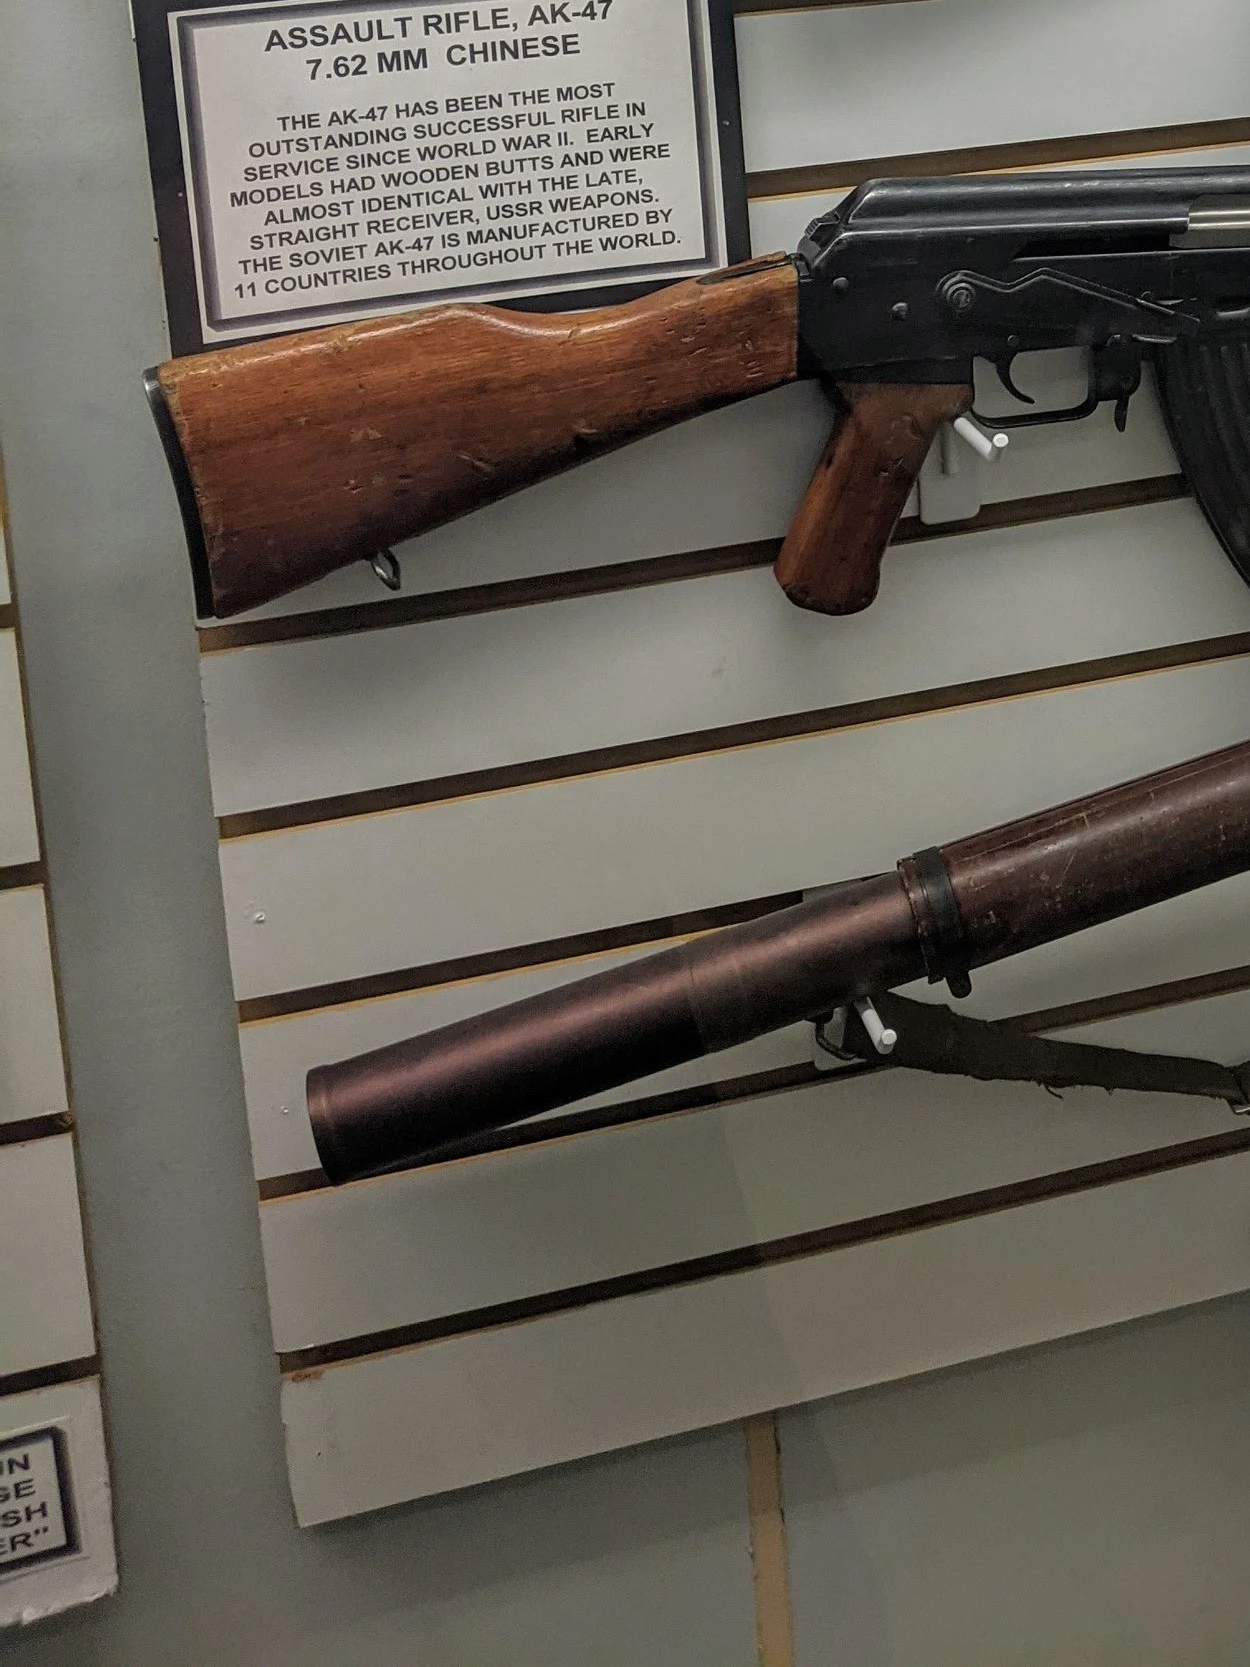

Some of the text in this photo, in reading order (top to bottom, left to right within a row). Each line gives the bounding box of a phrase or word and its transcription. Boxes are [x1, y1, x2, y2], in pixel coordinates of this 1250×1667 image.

[264, 16, 413, 52] ASSAULT
[422, 7, 518, 36] RIFLE,
[306, 33, 580, 81] 7.62 MM CHINESE
[248, 102, 646, 158] OUTSTANDING SUCCESSFUL RIFLE IN
[276, 82, 615, 132] THE AK-47 HAS BEEN THE MOST
[230, 143, 671, 208] MODELS HAD WOODEN BUTTS AND WERE
[244, 123, 654, 182] SERVICE SINCE WORLD WAR II. EARLY
[250, 189, 659, 251] STRAIGHT RECEIVER, USSR WEAPONS.
[264, 168, 643, 226] ALMOST IDENTICAL WITH THE LATE,
[234, 230, 682, 299] 11 COUNTRIES THROUGHOUT THE WORLD.
[238, 208, 673, 275] THE SOVIET AK-47 IS MANUFACTURED BY
